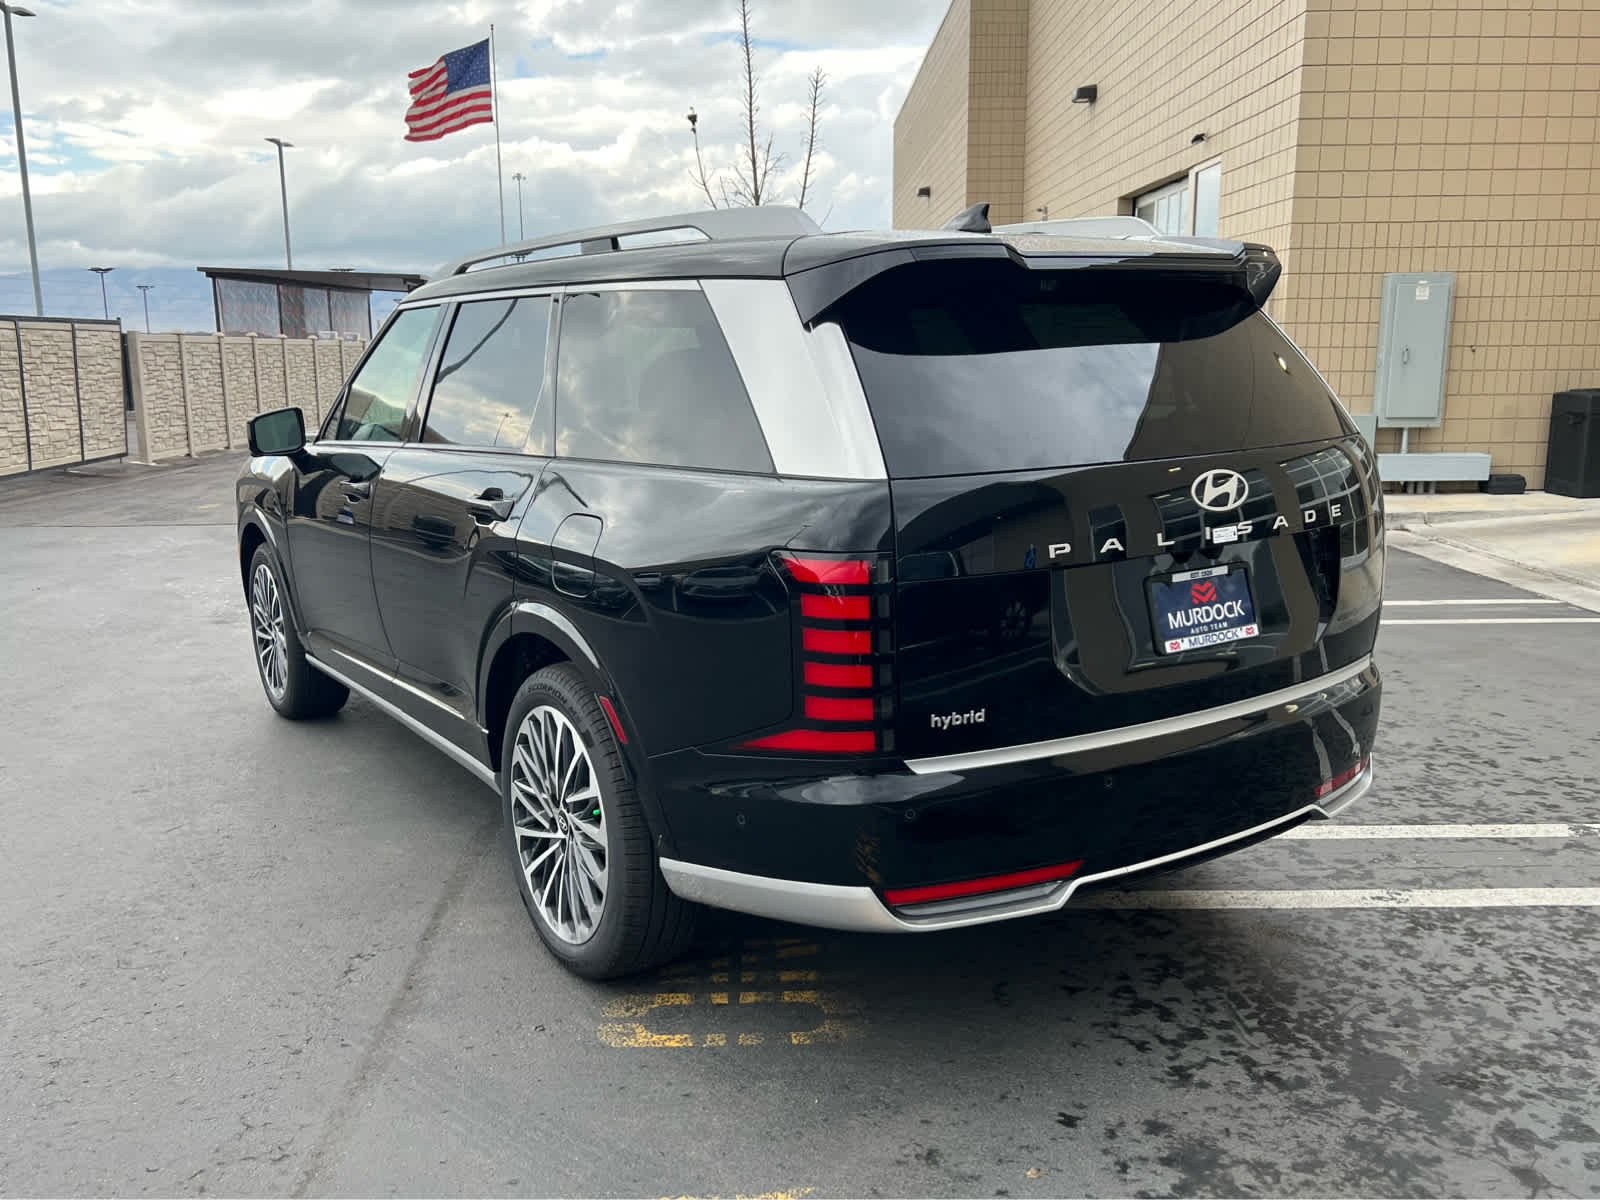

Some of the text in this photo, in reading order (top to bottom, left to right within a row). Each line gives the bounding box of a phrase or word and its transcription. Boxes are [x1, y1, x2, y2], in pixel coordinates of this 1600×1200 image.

[1048, 503, 1343, 560] PALISADE
[1167, 599, 1246, 630] MURDOCK
[1190, 621, 1229, 634] AUTO TEAM
[1188, 630, 1240, 648] MURDOCK
[930, 708, 986, 730] hybrid
